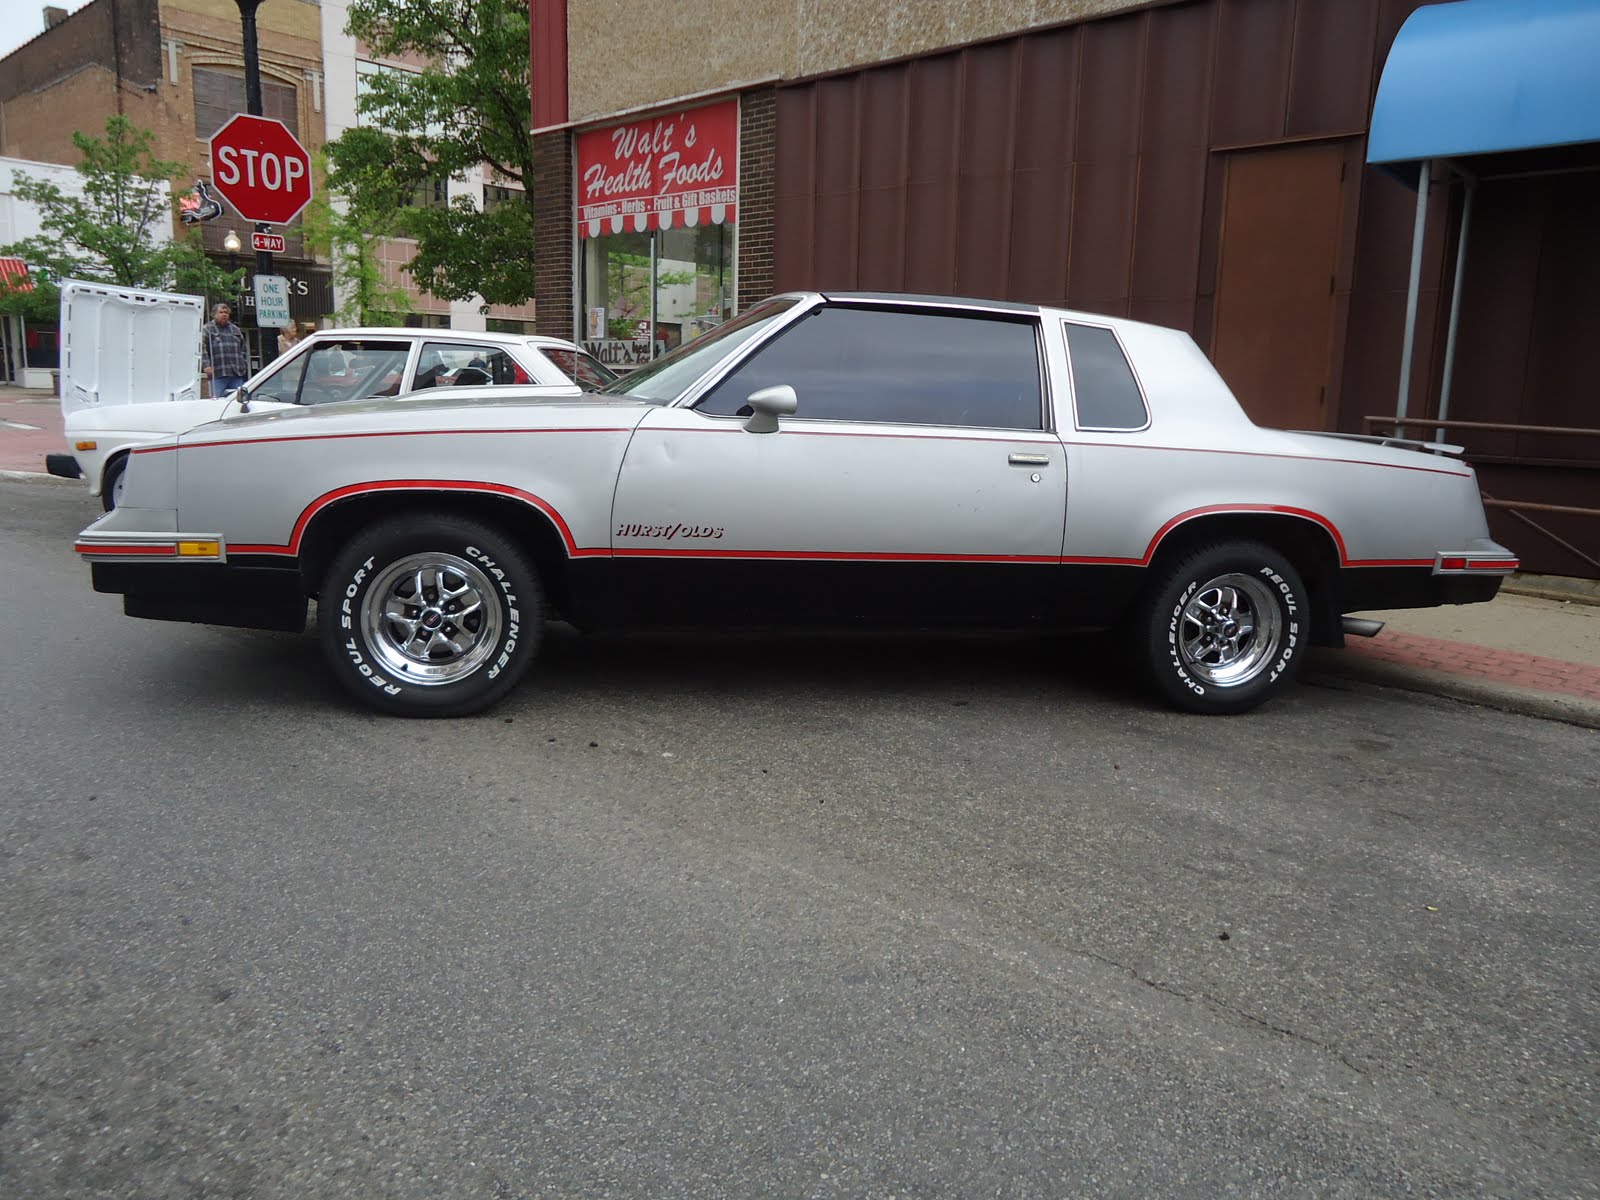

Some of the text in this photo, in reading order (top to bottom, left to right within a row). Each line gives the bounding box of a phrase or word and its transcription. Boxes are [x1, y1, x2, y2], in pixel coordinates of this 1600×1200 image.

[612, 113, 696, 160] Walt's
[218, 145, 304, 192] STOP
[584, 147, 724, 199] Health Foods
[583, 188, 736, 220] Vitamins Herbs Fruit & Gift Baskets
[254, 239, 282, 249] 4-WAY
[261, 296, 284, 307] HOUR
[263, 283, 280, 294] ONE
[259, 309, 288, 319] PARKING
[584, 341, 634, 363] Walt's
[616, 523, 724, 540] HURST/OLDS
[341, 556, 402, 695] REGUL SPORT
[466, 546, 520, 679] CHALLENGER
[1168, 581, 1205, 695] CHALLENGER
[1270, 621, 1298, 683] SPORT
